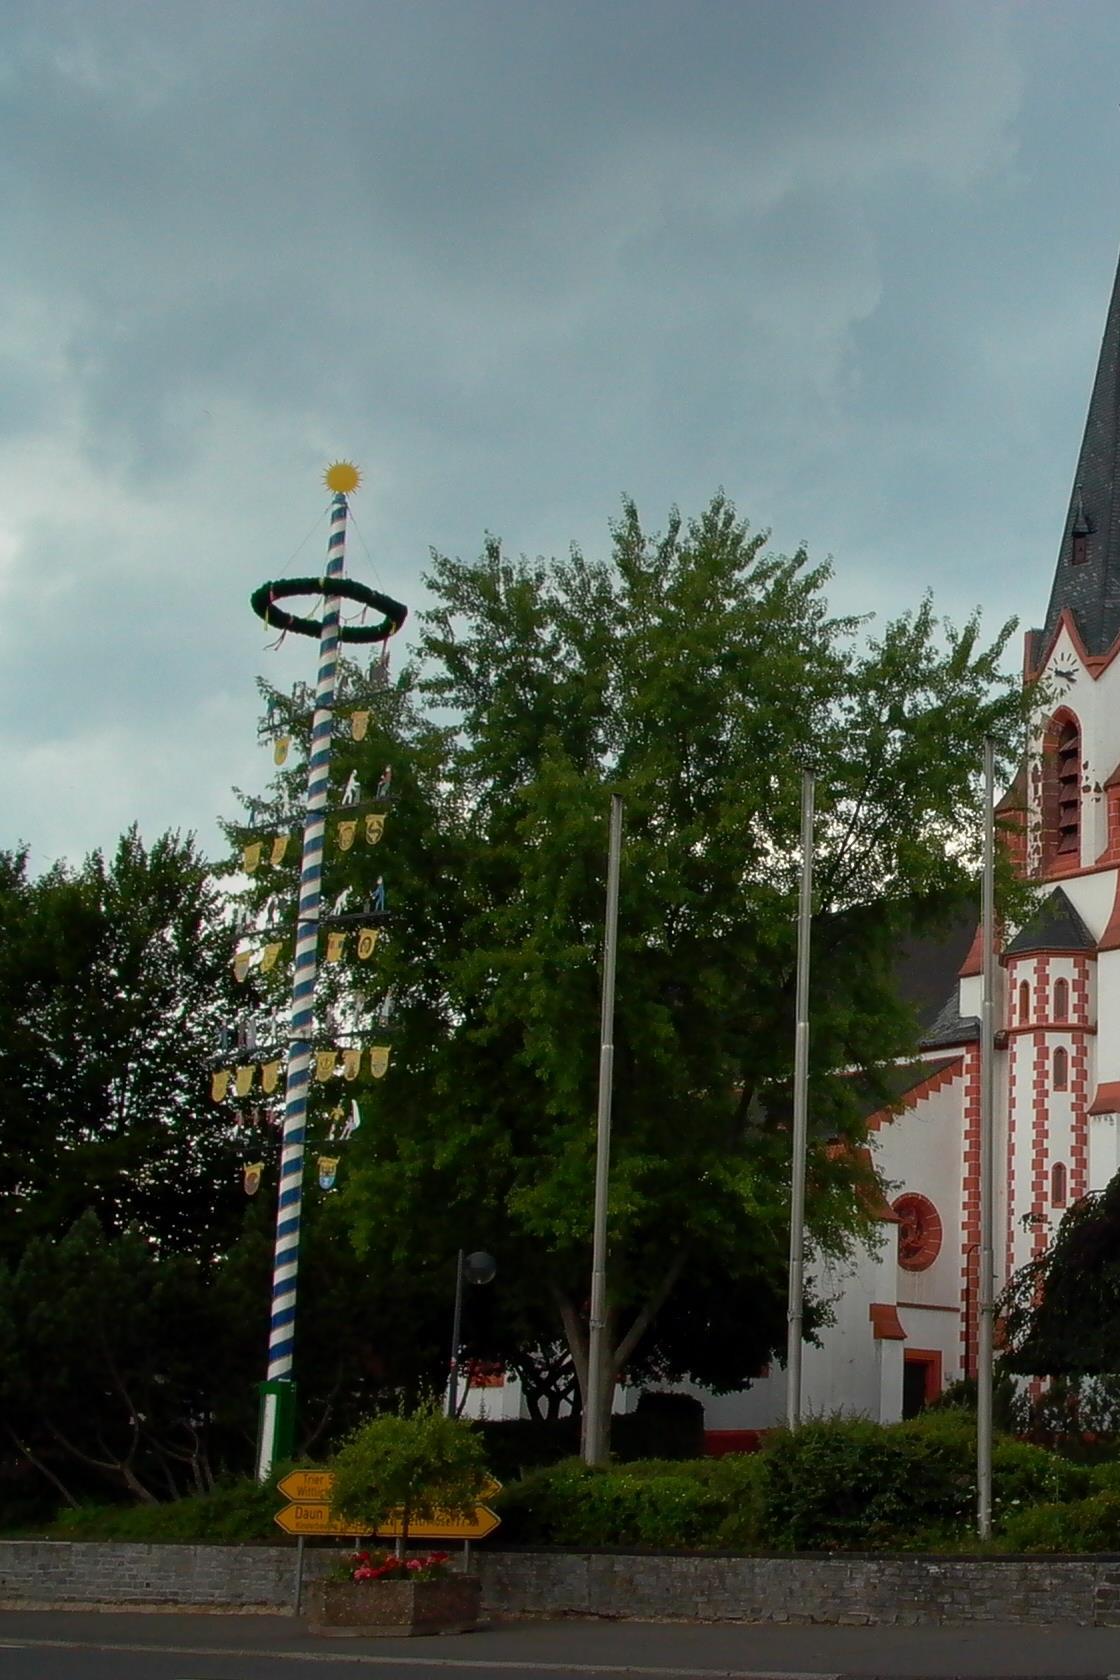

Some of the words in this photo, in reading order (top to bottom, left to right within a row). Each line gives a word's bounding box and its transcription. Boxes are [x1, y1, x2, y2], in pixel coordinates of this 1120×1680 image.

[303, 1473, 325, 1485] Trier
[296, 1486, 333, 1498] Wittlic
[294, 1507, 323, 1520] Daun
